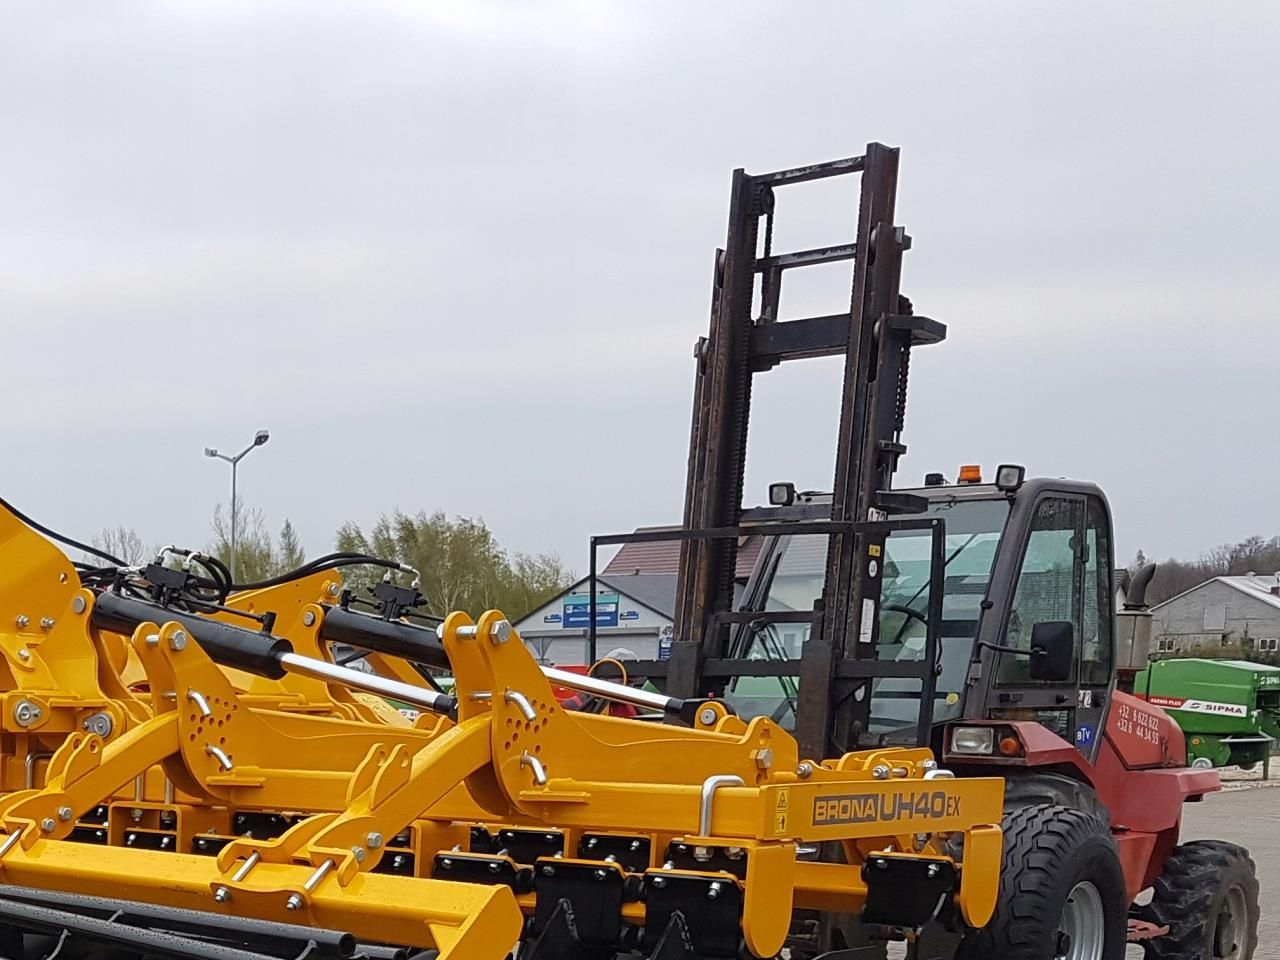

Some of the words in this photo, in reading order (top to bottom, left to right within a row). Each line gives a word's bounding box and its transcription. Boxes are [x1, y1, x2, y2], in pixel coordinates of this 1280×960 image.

[1205, 704, 1243, 714] SIPMA
[815, 798, 876, 821] BRONA
[879, 791, 946, 822] UH40
